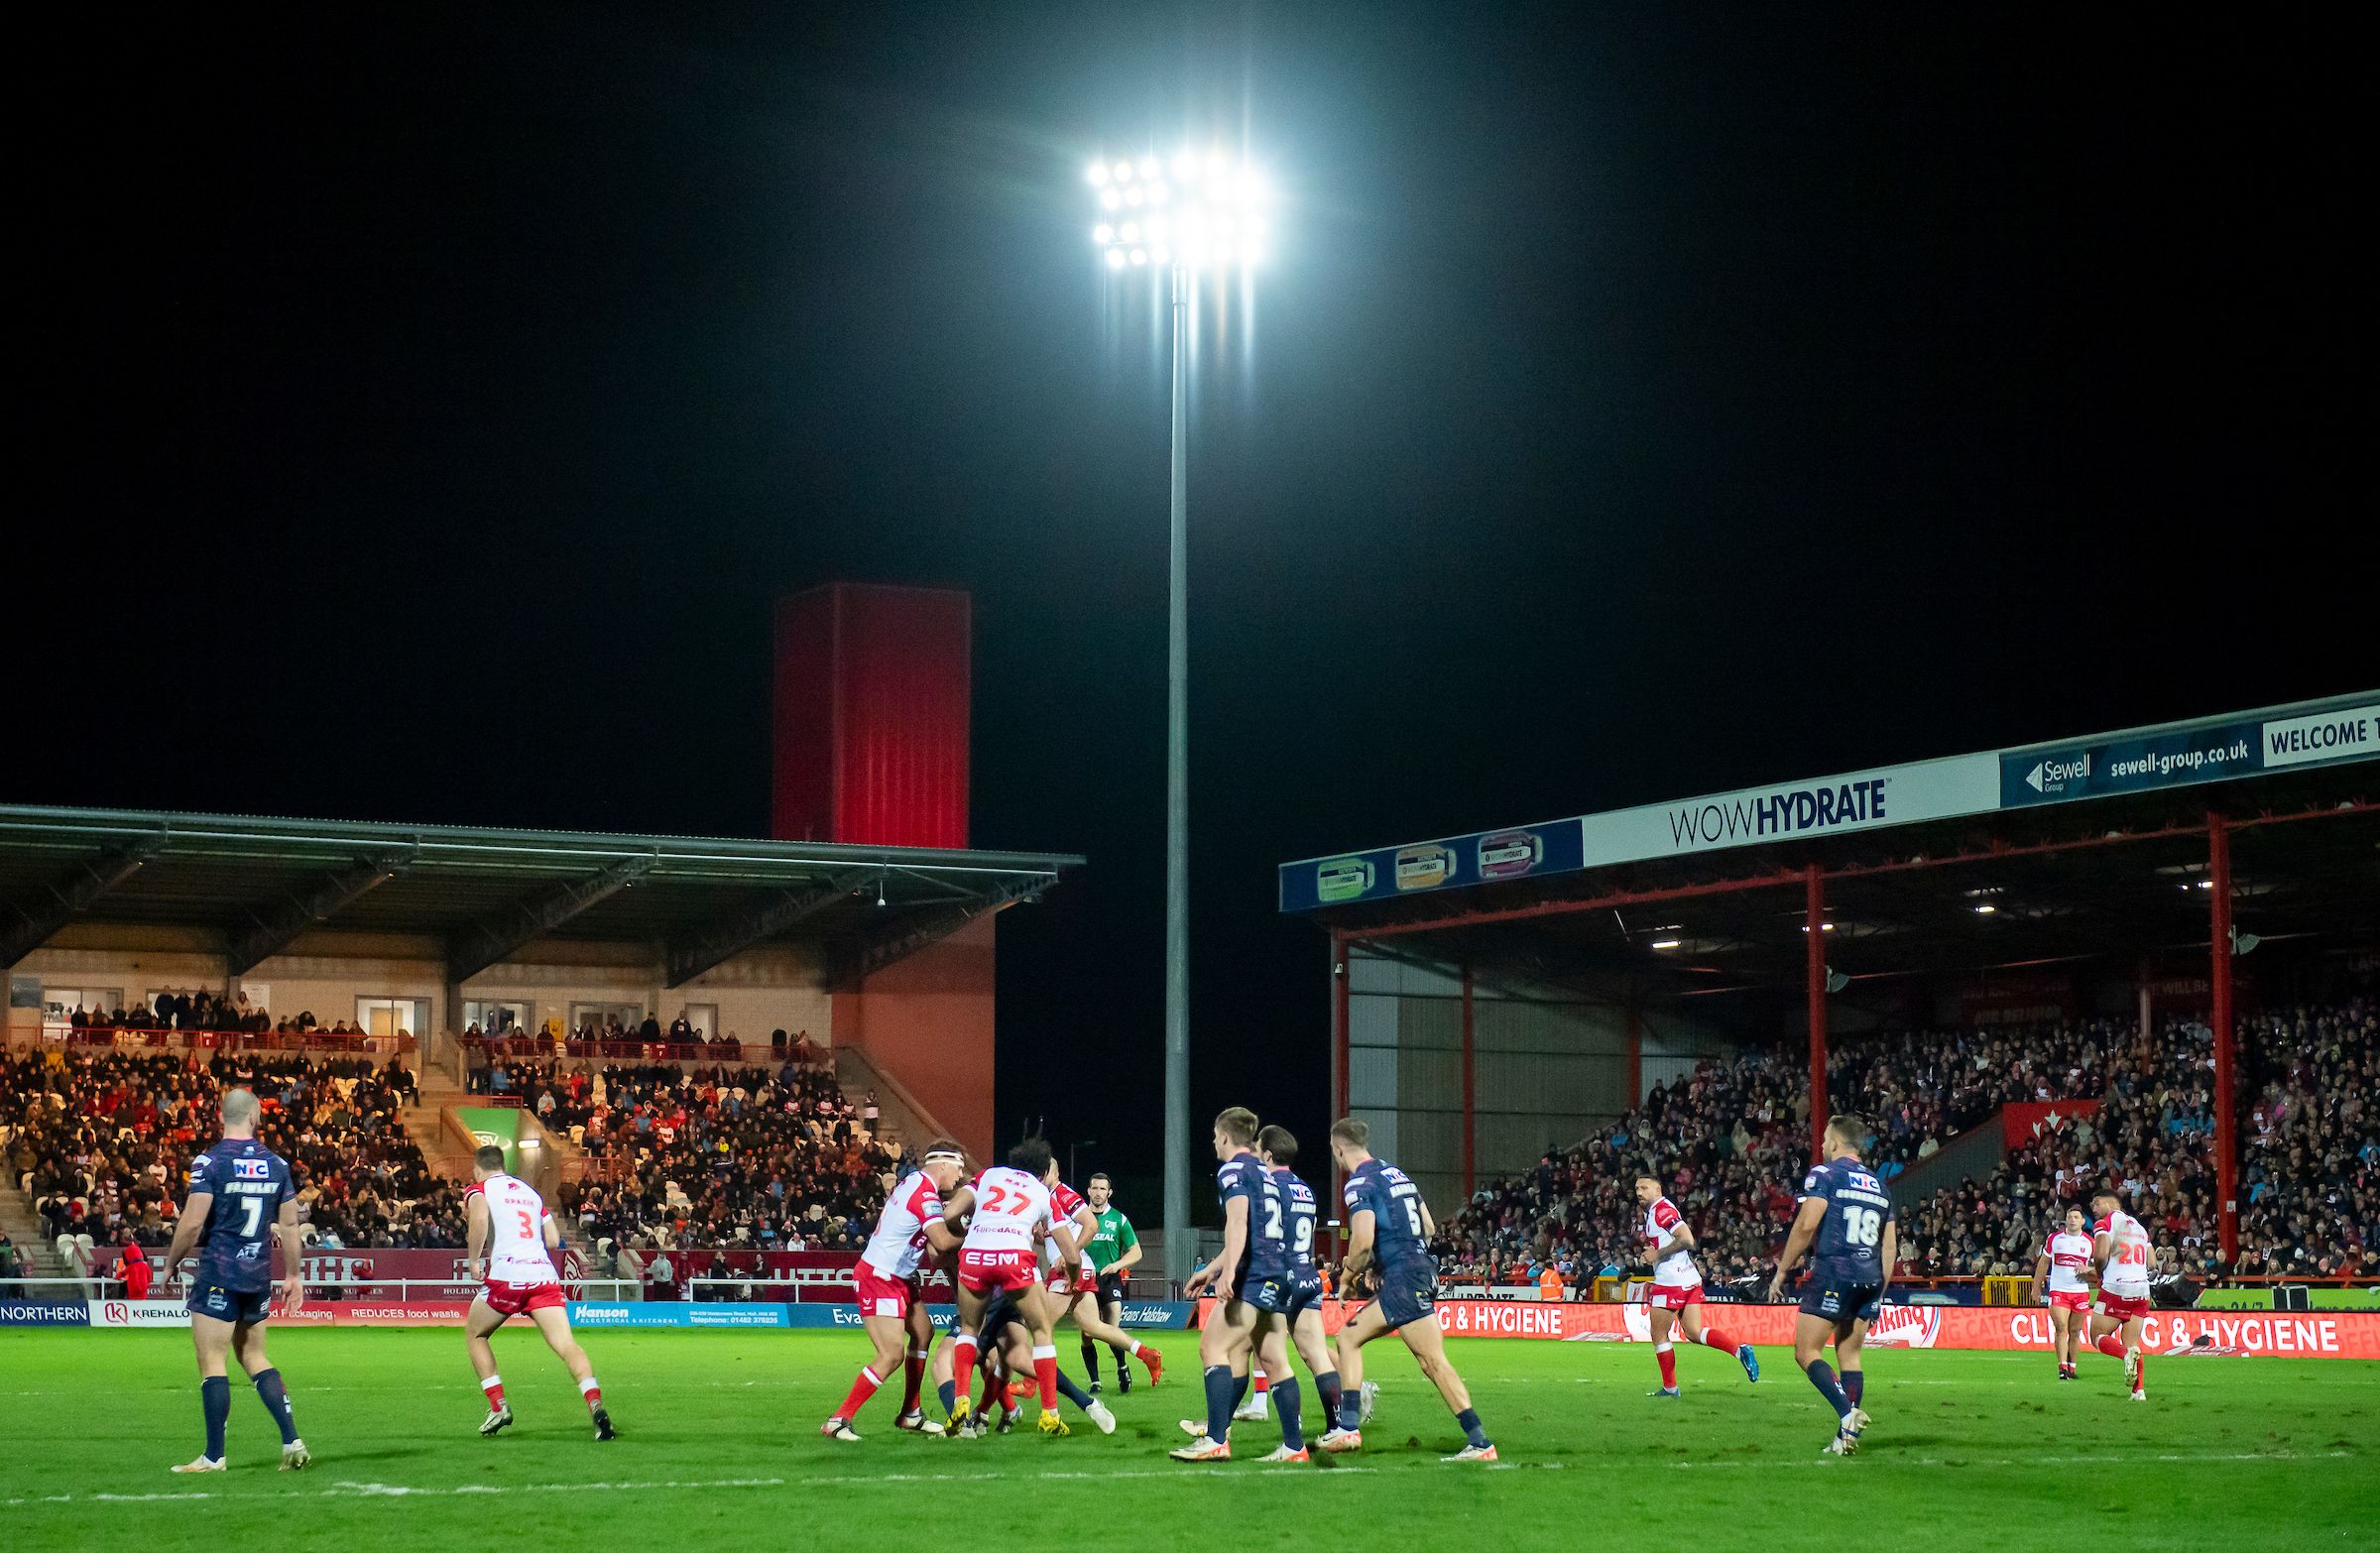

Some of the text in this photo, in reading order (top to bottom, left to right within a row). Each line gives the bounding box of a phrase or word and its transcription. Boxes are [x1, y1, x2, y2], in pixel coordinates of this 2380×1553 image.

[2270, 719, 2367, 755] WELCOME
[2044, 754, 2090, 781] Sewell
[2110, 739, 2249, 777] sewell-group.co.uk
[2044, 782, 2065, 793] Group
[1669, 777, 1887, 848] WOWHYDRATE
[982, 1185, 1031, 1216] 27
[239, 1196, 264, 1239] 7
[517, 1210, 535, 1239] 3
[1403, 1196, 1421, 1237] 5
[1843, 1205, 1881, 1247] 18
[1292, 1216, 1313, 1253] 9
[965, 1251, 1019, 1266] ESM
[2118, 1243, 2145, 1265] 20
[0, 1306, 87, 1321] NORTHERN
[133, 1308, 190, 1320] KREHALO
[281, 1309, 336, 1321] Pckaging.
[351, 1308, 463, 1319] REDUCES food waste.
[574, 1303, 630, 1319] Hanson
[832, 1308, 863, 1325] Eva
[1140, 1305, 1172, 1324] Halshaw
[1456, 1305, 1469, 1331] &
[1475, 1305, 1563, 1335] HYGIENE
[2171, 1317, 2191, 1347] &
[2200, 1318, 2340, 1352] HYGIENE
